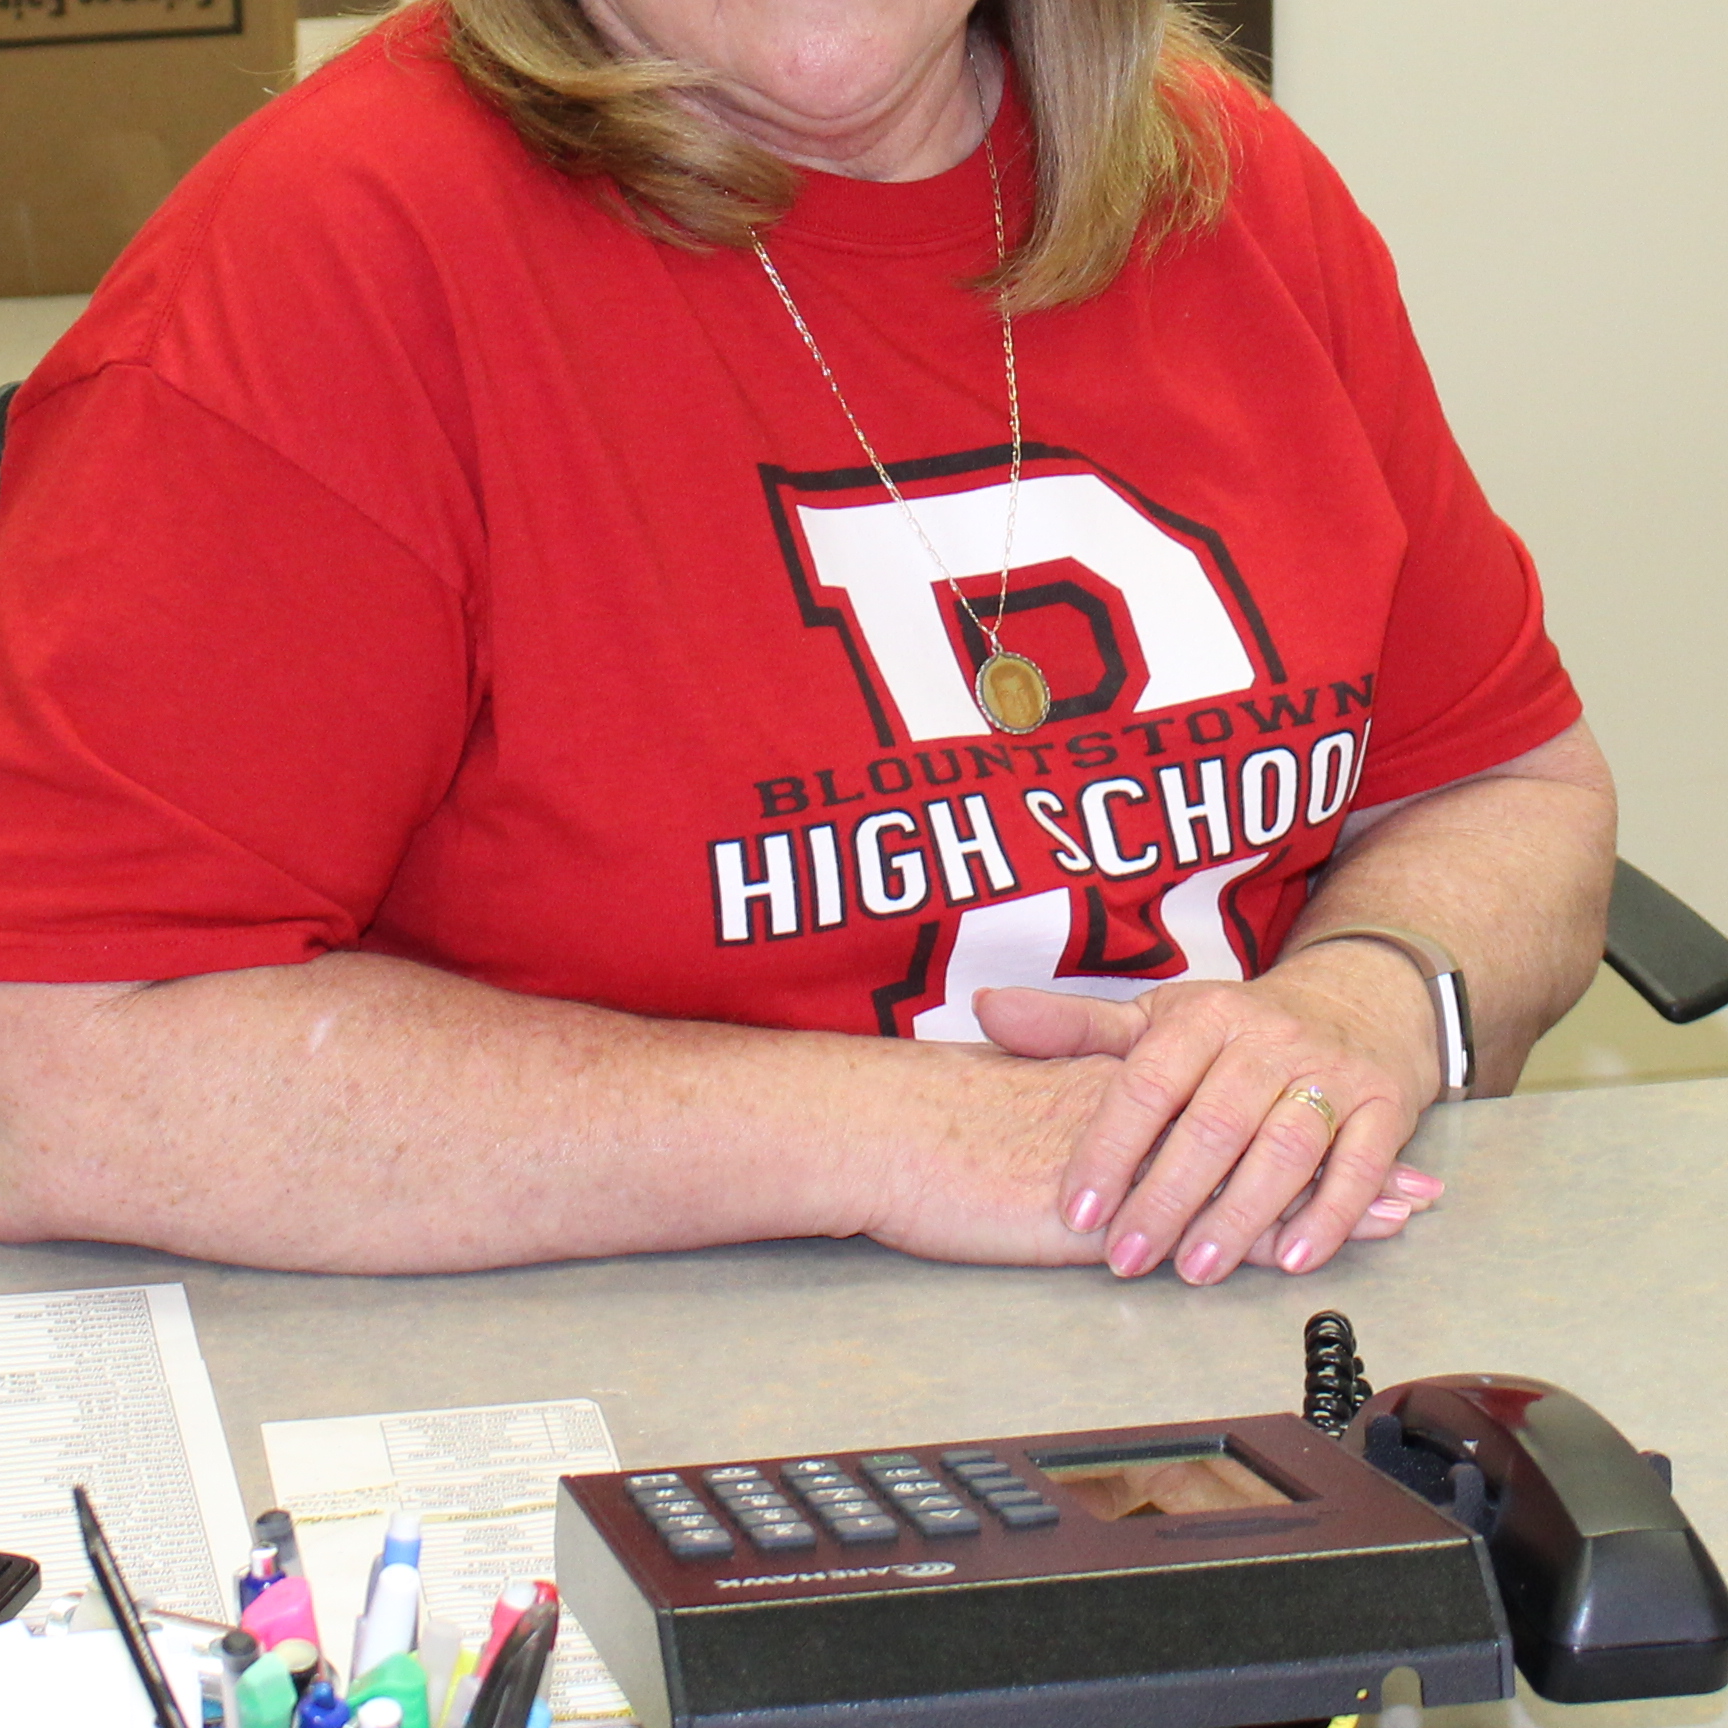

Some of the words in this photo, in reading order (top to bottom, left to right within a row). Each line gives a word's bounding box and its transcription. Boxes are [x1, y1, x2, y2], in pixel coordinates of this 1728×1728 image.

[708, 793, 1020, 948] HIGH
[1022, 717, 1373, 876] SCHOO
[753, 674, 1374, 819] BLOUNTSTOWN
